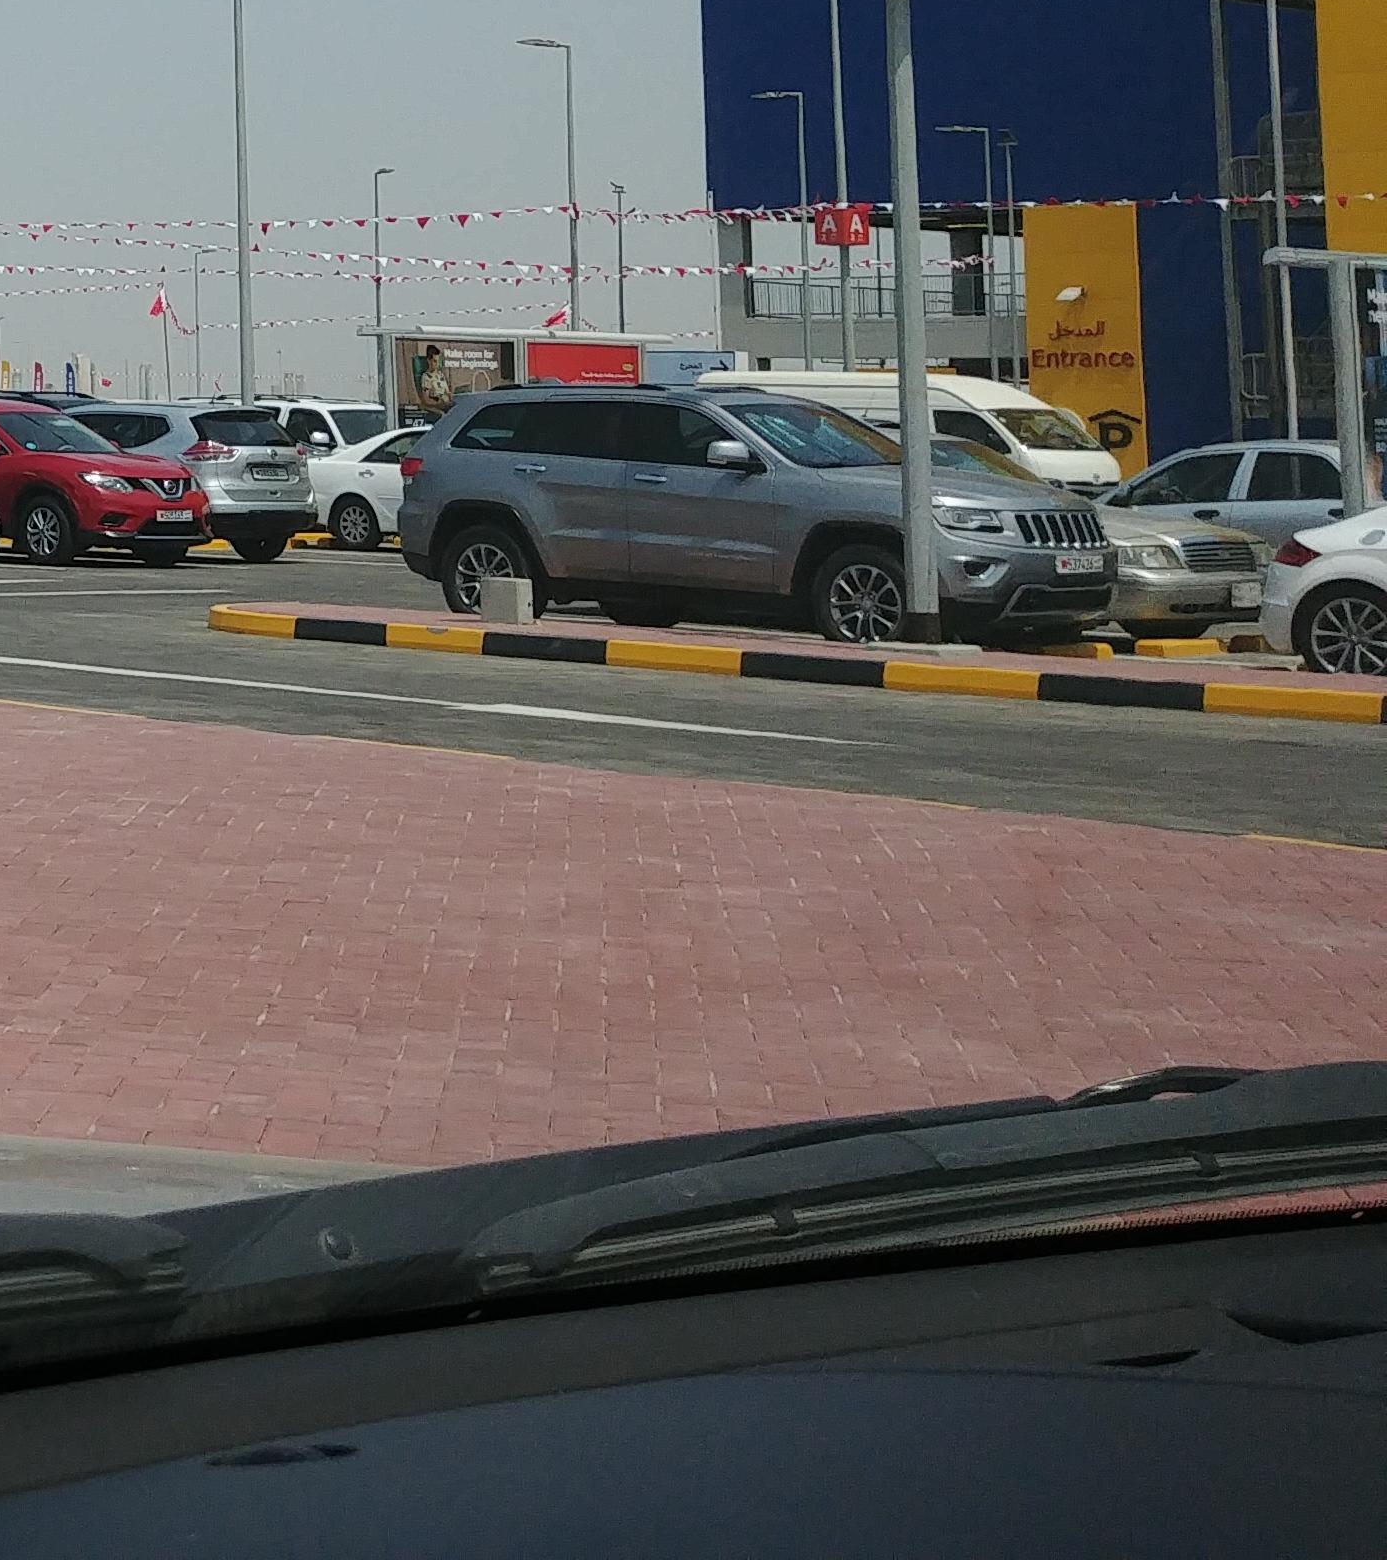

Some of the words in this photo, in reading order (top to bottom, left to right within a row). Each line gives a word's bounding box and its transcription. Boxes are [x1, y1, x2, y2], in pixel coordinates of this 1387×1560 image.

[821, 213, 838, 233] A
[849, 213, 864, 234] A
[1031, 348, 1135, 369] Entrance
